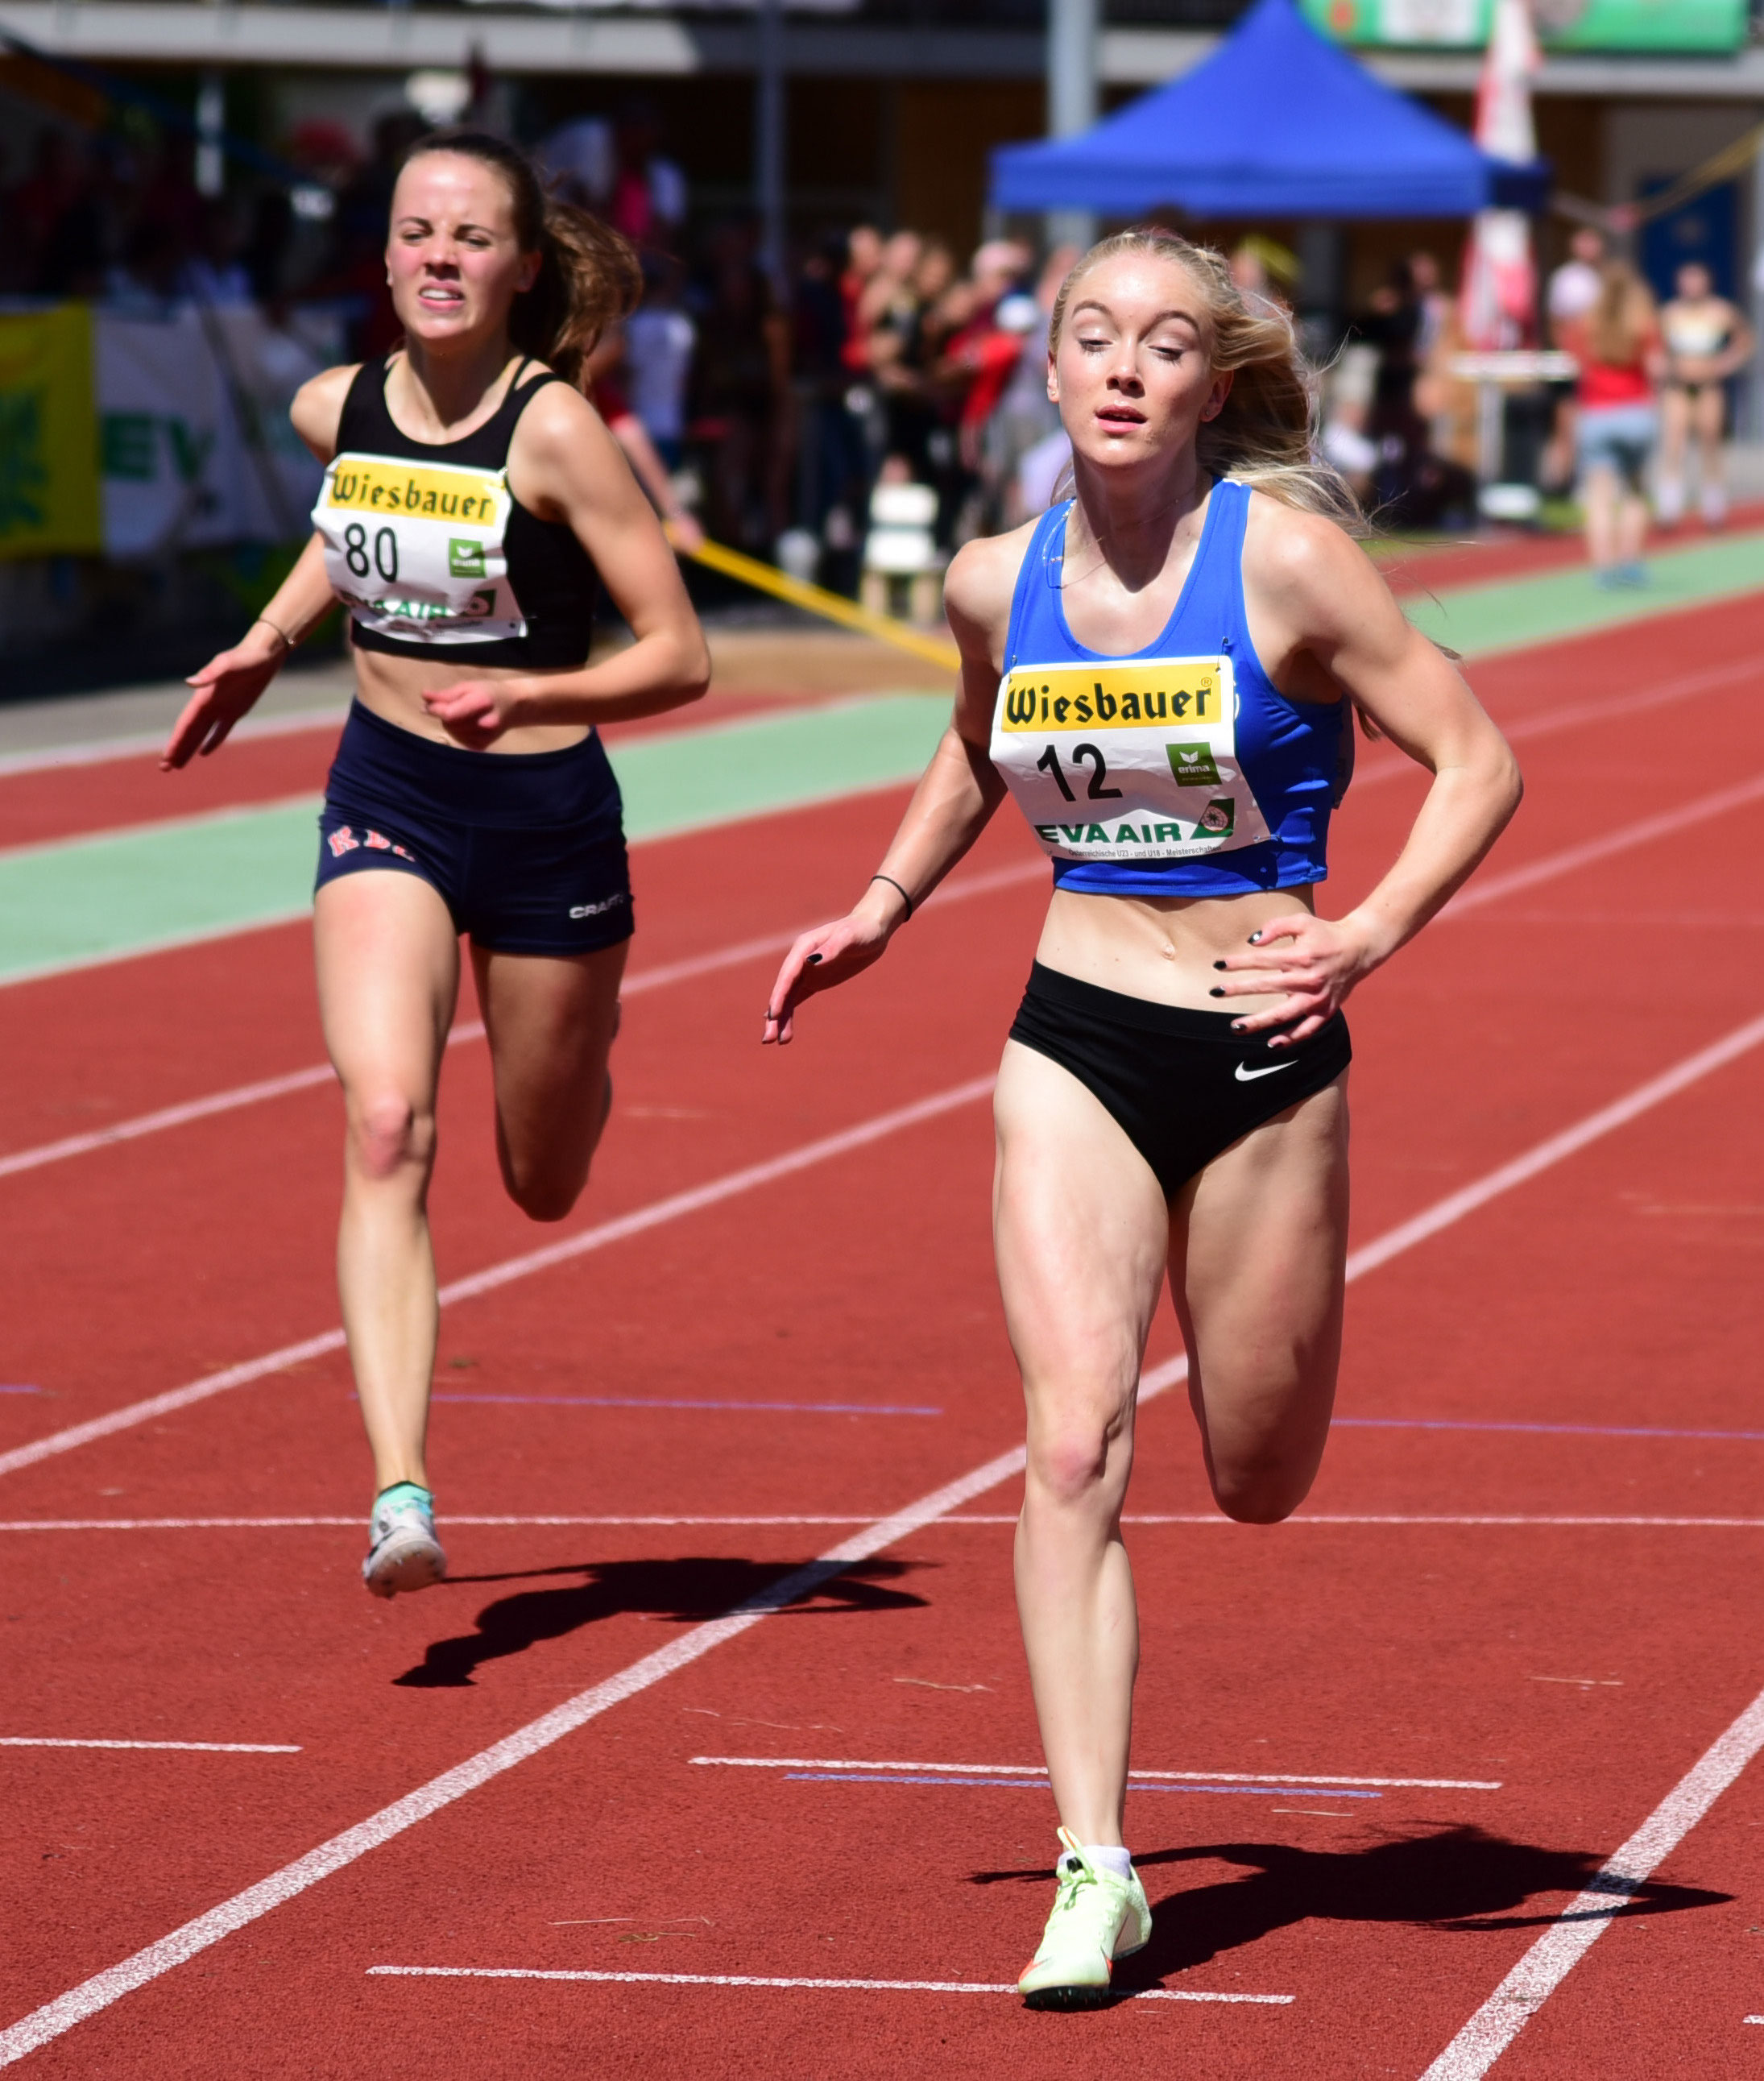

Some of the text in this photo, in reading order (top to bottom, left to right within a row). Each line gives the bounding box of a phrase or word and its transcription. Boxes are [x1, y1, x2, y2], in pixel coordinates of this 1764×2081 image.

[331, 472, 491, 520] Wiesbauer
[345, 522, 400, 583] 80
[1037, 743, 1124, 802] 12
[1178, 764, 1210, 774] erima
[1034, 823, 1182, 844] EVA AIR
[1117, 849, 1128, 857] U23
[1134, 849, 1147, 857] und
[1148, 849, 1160, 857] U18
